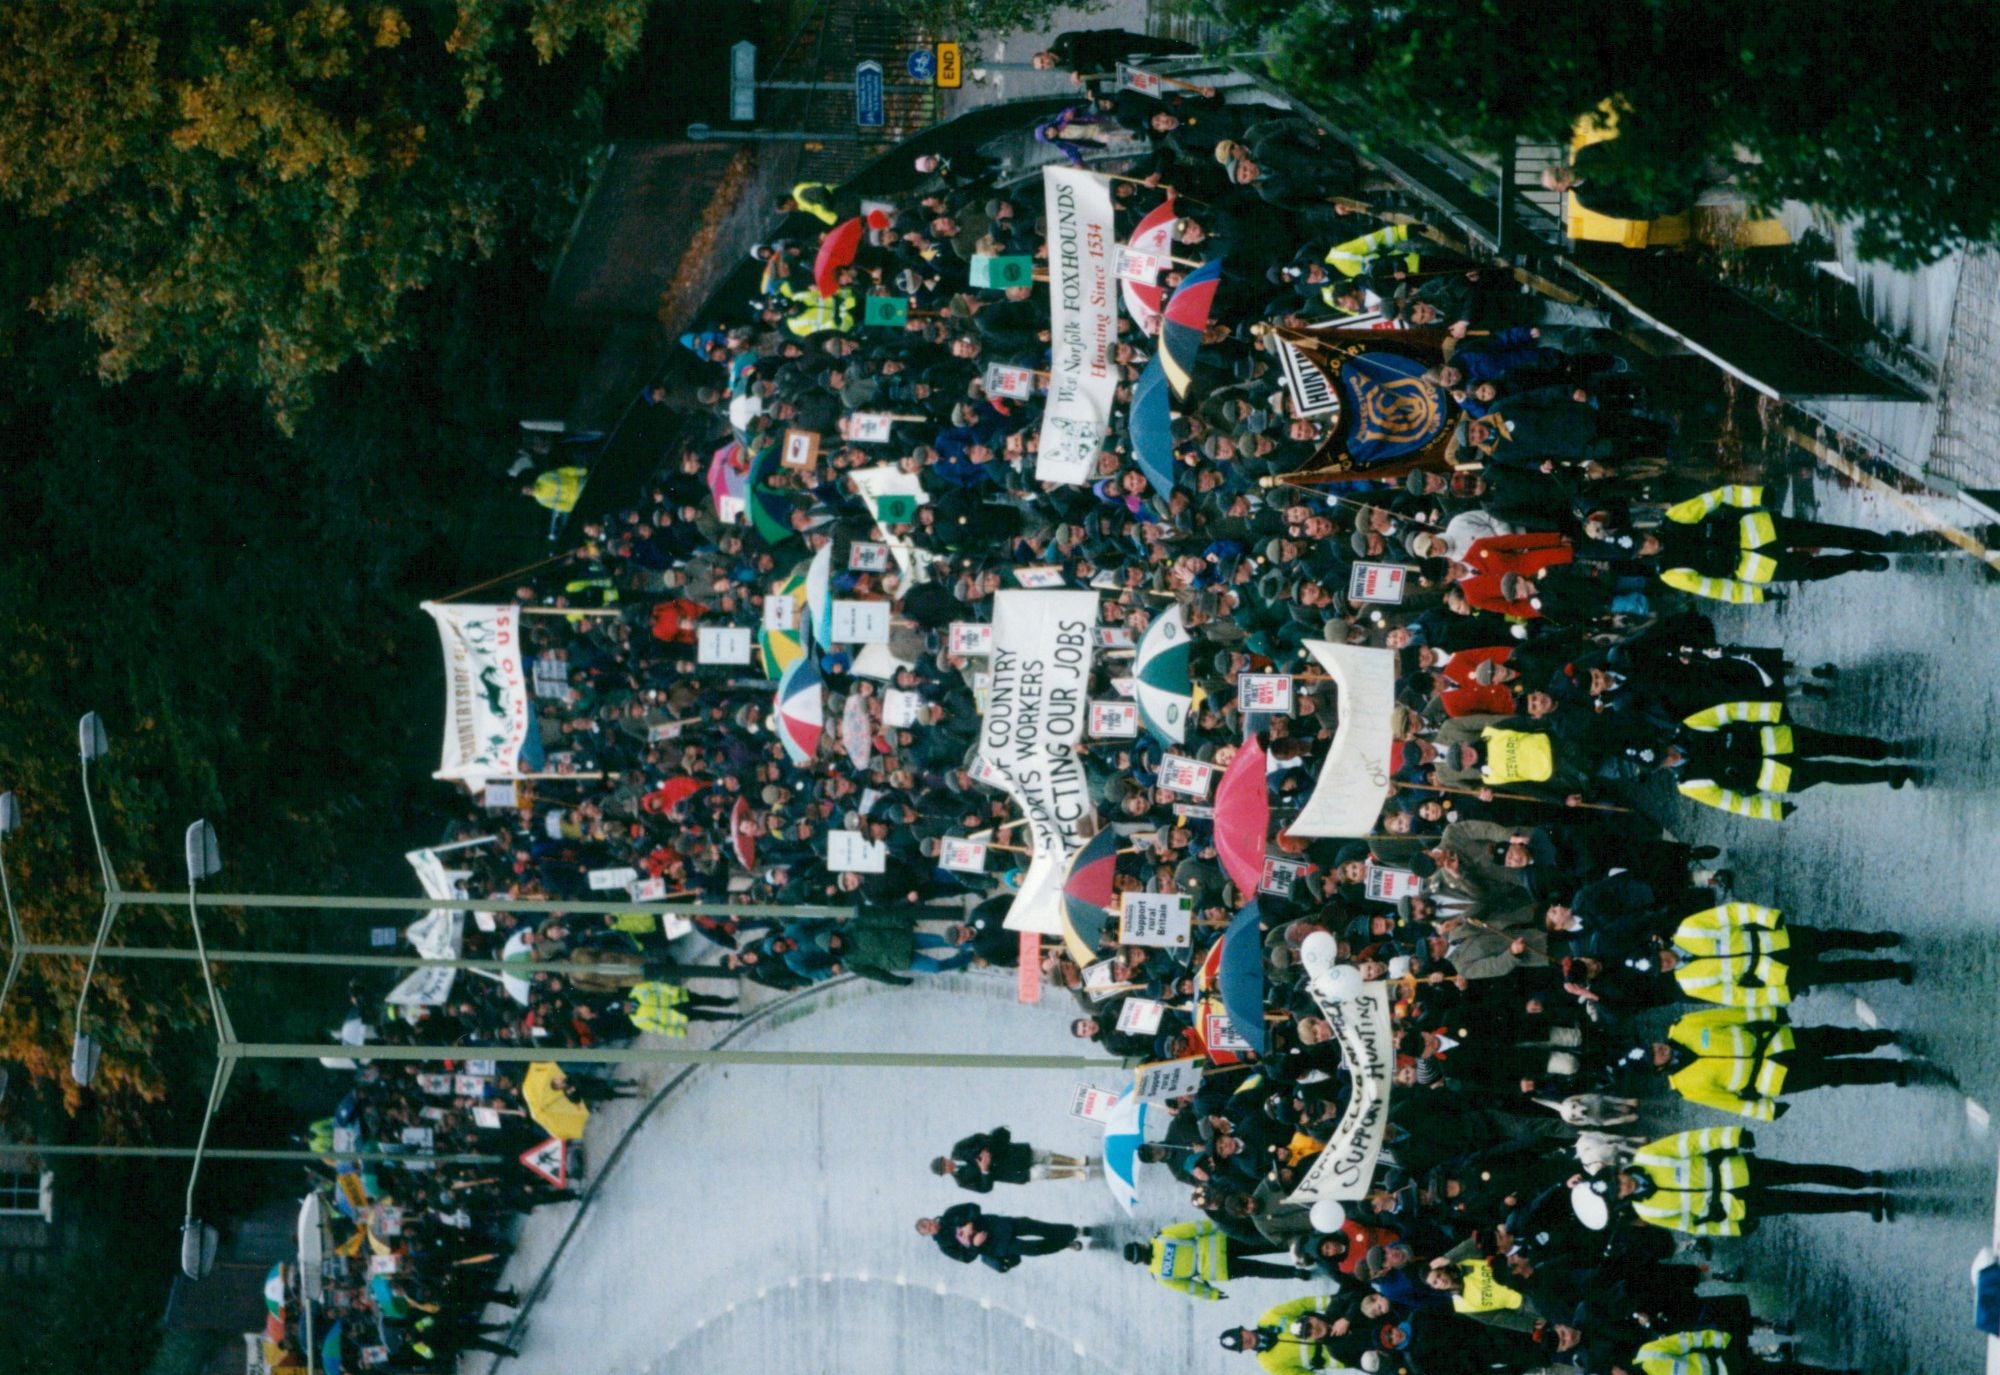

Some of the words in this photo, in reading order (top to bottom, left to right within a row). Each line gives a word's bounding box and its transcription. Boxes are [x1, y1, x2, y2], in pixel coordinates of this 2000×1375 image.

[943, 50, 955, 80] END
[1055, 183, 1081, 312] FOXHOUNDS
[1086, 223, 1104, 258] 1534
[1089, 265, 1106, 307] Since
[1062, 320, 1087, 374] Norfolk
[1089, 313, 1111, 379] Hunting
[1056, 377, 1078, 403] Wes
[1290, 343, 1330, 405] HUNTIN
[1052, 620, 1087, 679] JOBS
[502, 658, 518, 686] TO
[988, 646, 1017, 749] COUNTRY
[1015, 659, 1045, 761] WORKERS
[1045, 687, 1078, 736] OUR
[1135, 900, 1147, 937] Support
[1148, 908, 1156, 931] rural
[1156, 904, 1167, 936] Britain
[1354, 996, 1385, 1080] HUNTING
[1146, 1069, 1161, 1097] Support
[1167, 1067, 1181, 1092] Britain
[1162, 1246, 1175, 1275] POLICE
[1480, 1265, 1493, 1307] STEWARD
